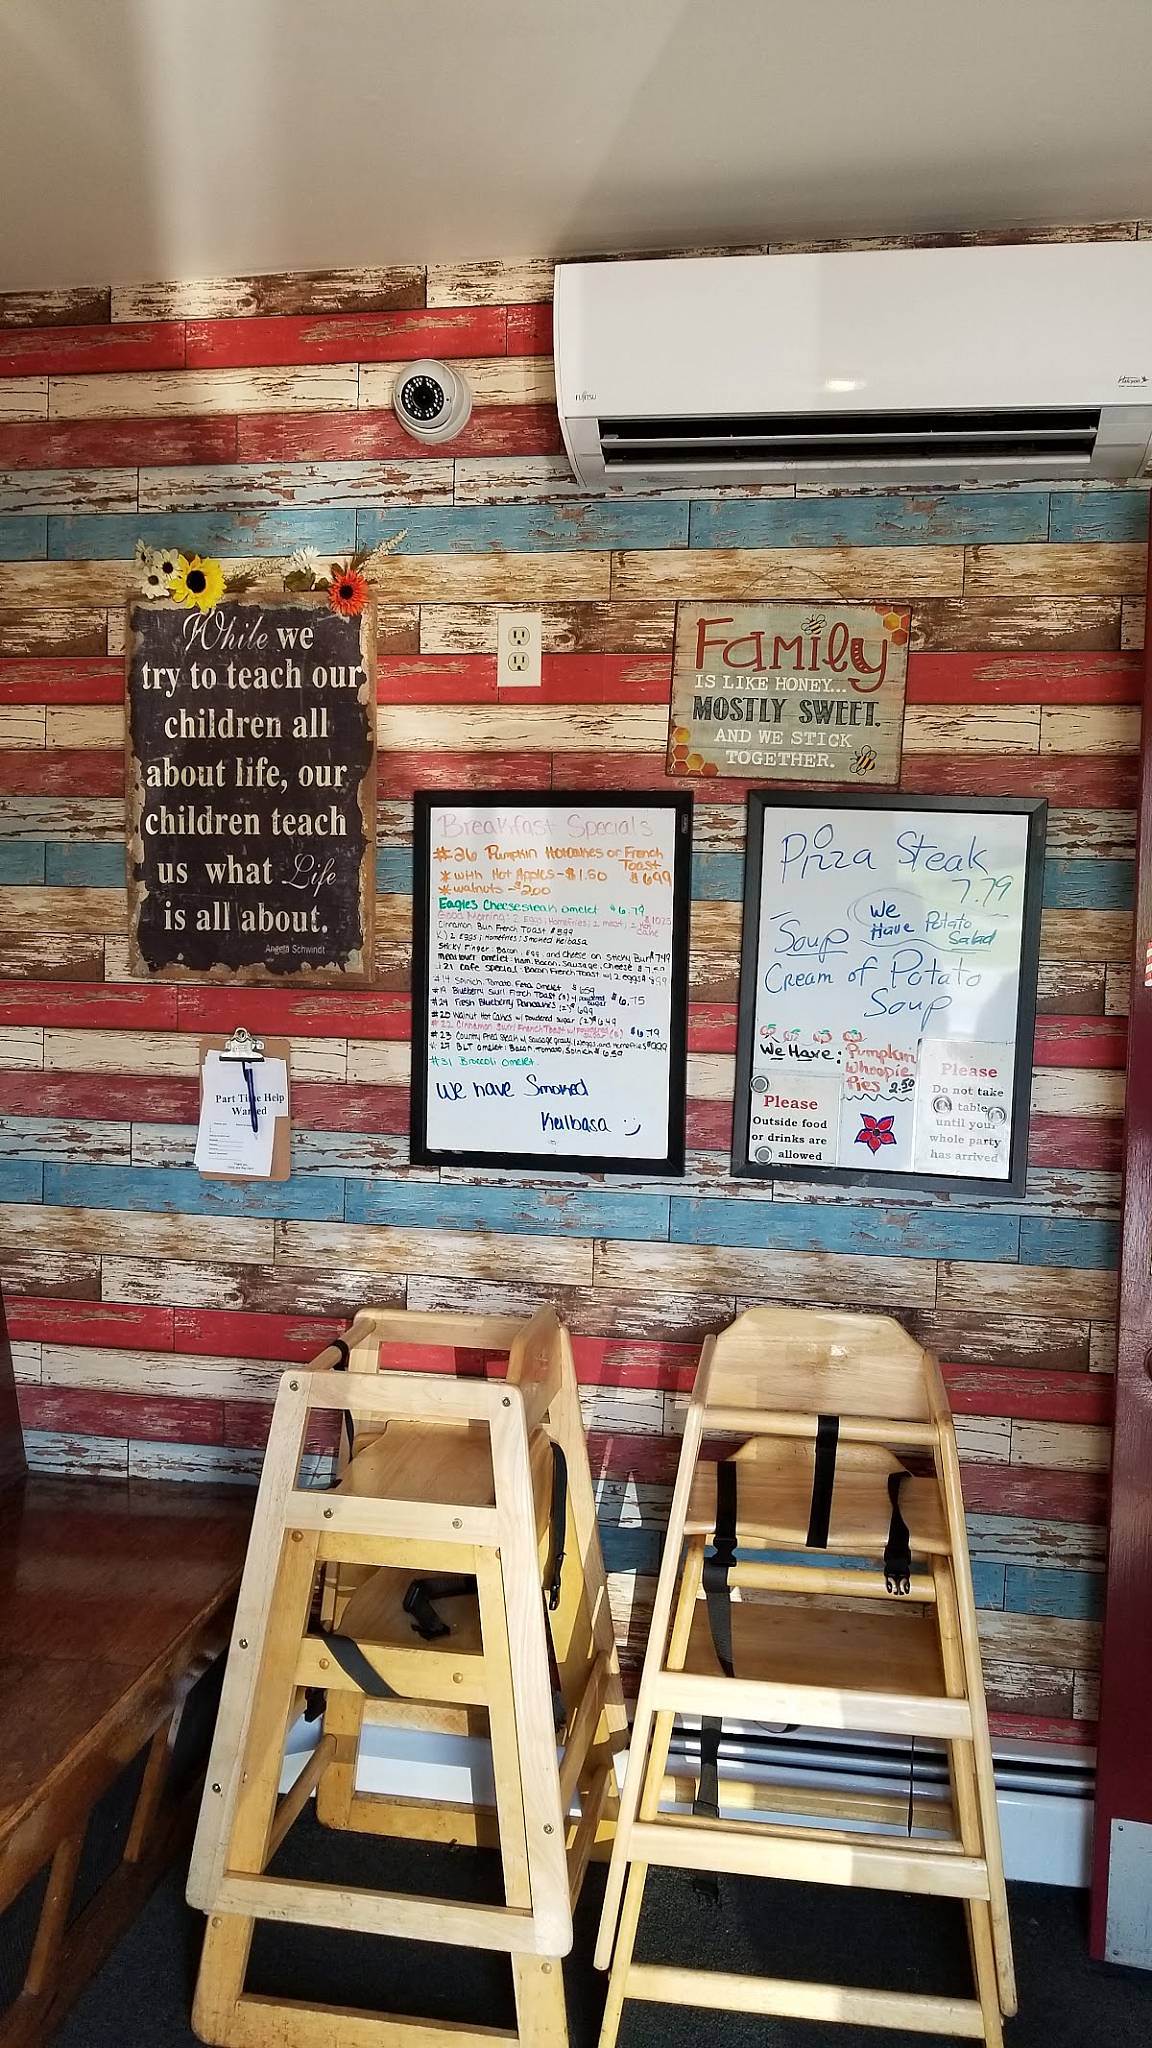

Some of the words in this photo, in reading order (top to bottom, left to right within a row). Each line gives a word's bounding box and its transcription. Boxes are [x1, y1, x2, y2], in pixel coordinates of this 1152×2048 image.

[182, 610, 269, 652] While
[277, 626, 315, 650] we
[141, 663, 181, 698] try
[189, 665, 218, 691] to
[227, 658, 303, 689] teach
[312, 665, 361, 689] our
[694, 674, 716, 690] IS
[722, 675, 769, 691] LIKE
[775, 676, 847, 694] HONEY...
[692, 695, 788, 724] MOSTLY
[799, 699, 881, 728] SWEET.
[163, 709, 281, 739] children
[293, 707, 329, 739] all
[713, 728, 751, 743] AND
[758, 730, 783, 745] WE
[790, 730, 852, 748] STICK
[725, 750, 836, 768] TOGETHER.
[146, 758, 225, 788] about
[236, 757, 289, 794] life,
[298, 765, 348, 788] our
[145, 805, 260, 836] children
[271, 805, 348, 836] teach
[437, 813, 557, 838] Breakfast
[567, 814, 654, 839] Specials
[624, 846, 664, 860] French
[780, 823, 877, 884] Pizza
[896, 829, 990, 875] Steak
[157, 860, 188, 885] us
[205, 855, 273, 885] what
[281, 853, 337, 898] Life
[951, 875, 1015, 907] 7.79
[438, 897, 479, 912] Eagles
[163, 901, 186, 931] is
[196, 901, 230, 931] all
[239, 901, 328, 934] about.
[265, 944, 290, 955] Angela
[292, 944, 326, 955] Schwindt
[774, 919, 850, 964] Soup
[847, 955, 879, 987] of
[890, 948, 983, 989] Potato
[863, 987, 953, 1031] Soup
[759, 1042, 786, 1056] We
[846, 1042, 918, 1064] Pumpkin
[845, 1061, 915, 1083] Whoopie
[941, 1062, 998, 1078] Please
[435, 1081, 467, 1101] We
[523, 1072, 590, 1097] Smoked
[846, 1075, 881, 1093] Pies
[888, 1078, 916, 1094] 2.50
[932, 1084, 949, 1094] Do
[952, 1086, 974, 1096] not
[977, 1087, 1004, 1097] take
[215, 1094, 235, 1103] Part
[237, 1093, 262, 1103] Tie
[264, 1093, 285, 1104] Help
[763, 1094, 819, 1110] Please
[231, 1106, 267, 1116] Waned
[752, 1115, 798, 1128] Outside
[802, 1118, 828, 1129] food
[936, 1118, 965, 1128] until
[751, 1133, 764, 1141] or
[767, 1133, 805, 1144] drinks
[808, 1137, 827, 1145] are
[929, 1134, 965, 1144] whole
[969, 1137, 1003, 1149] party
[778, 1149, 823, 1161] allowed
[930, 1149, 952, 1159] has
[955, 1152, 999, 1163] arrived
